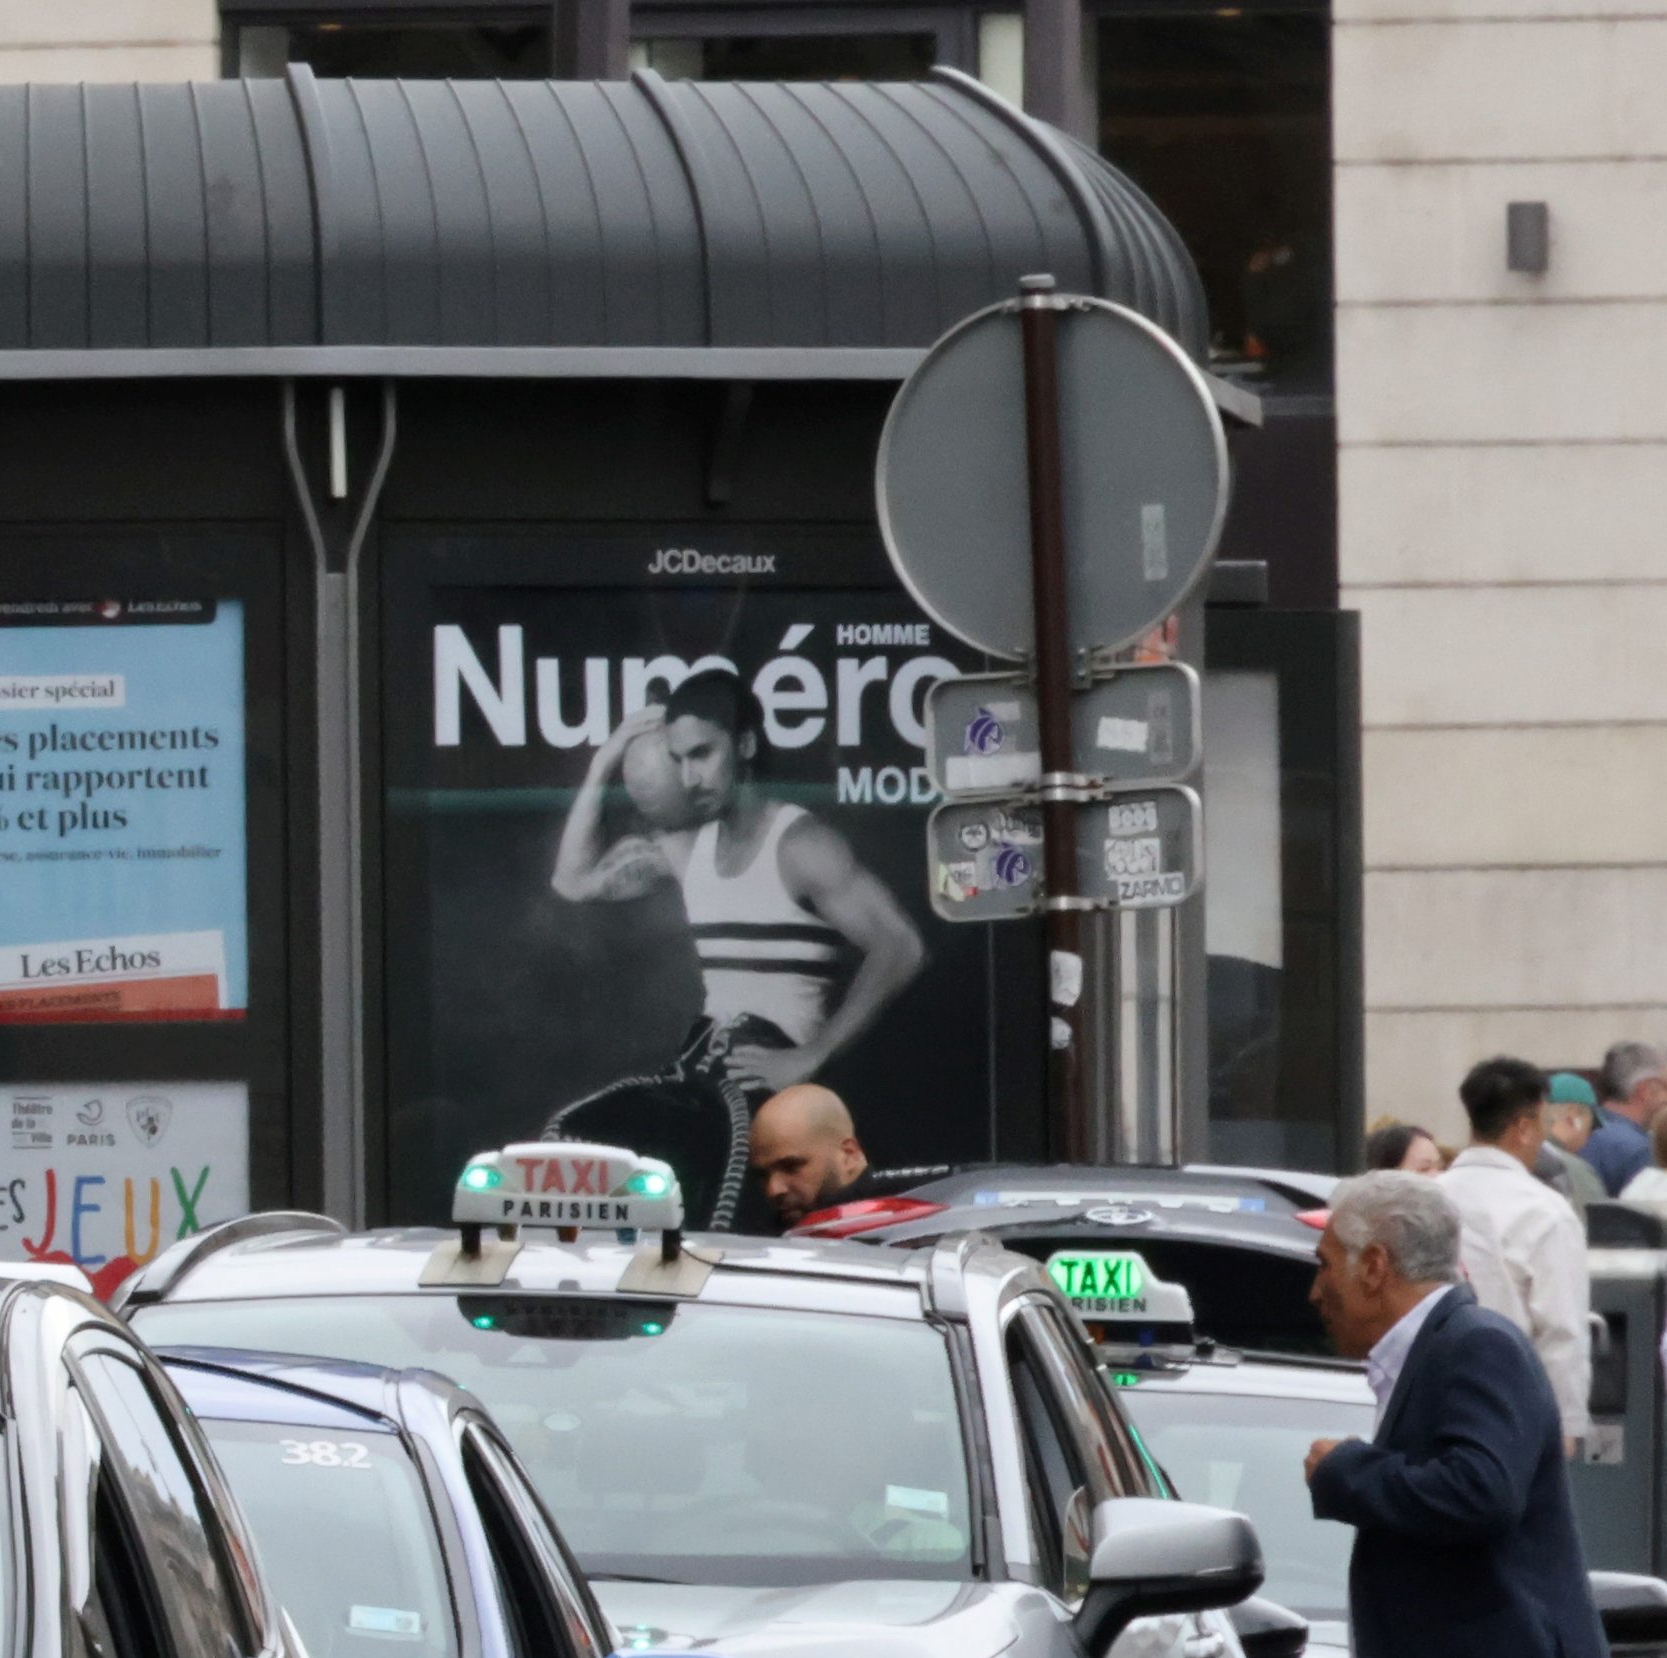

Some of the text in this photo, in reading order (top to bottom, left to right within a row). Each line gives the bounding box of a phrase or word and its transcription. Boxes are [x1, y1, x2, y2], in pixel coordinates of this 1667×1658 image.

[648, 549, 776, 575] JCDecaux
[836, 624, 931, 646] HOMME
[45, 680, 115, 703] spécial
[29, 724, 220, 760] placements
[26, 764, 210, 798] rapportent
[836, 766, 949, 804] MOD
[17, 806, 49, 831] et
[58, 802, 129, 837] plus
[21, 945, 162, 979] Les Echos
[66, 1133, 116, 1147] PARIS
[516, 1157, 610, 1195] TAXI
[22, 1165, 211, 1266] JEUX
[503, 1201, 630, 1221] PARISIEN
[1059, 1259, 1133, 1296] TAXI
[1071, 1296, 1147, 1313] RISIEN
[279, 1440, 373, 1469] 382
